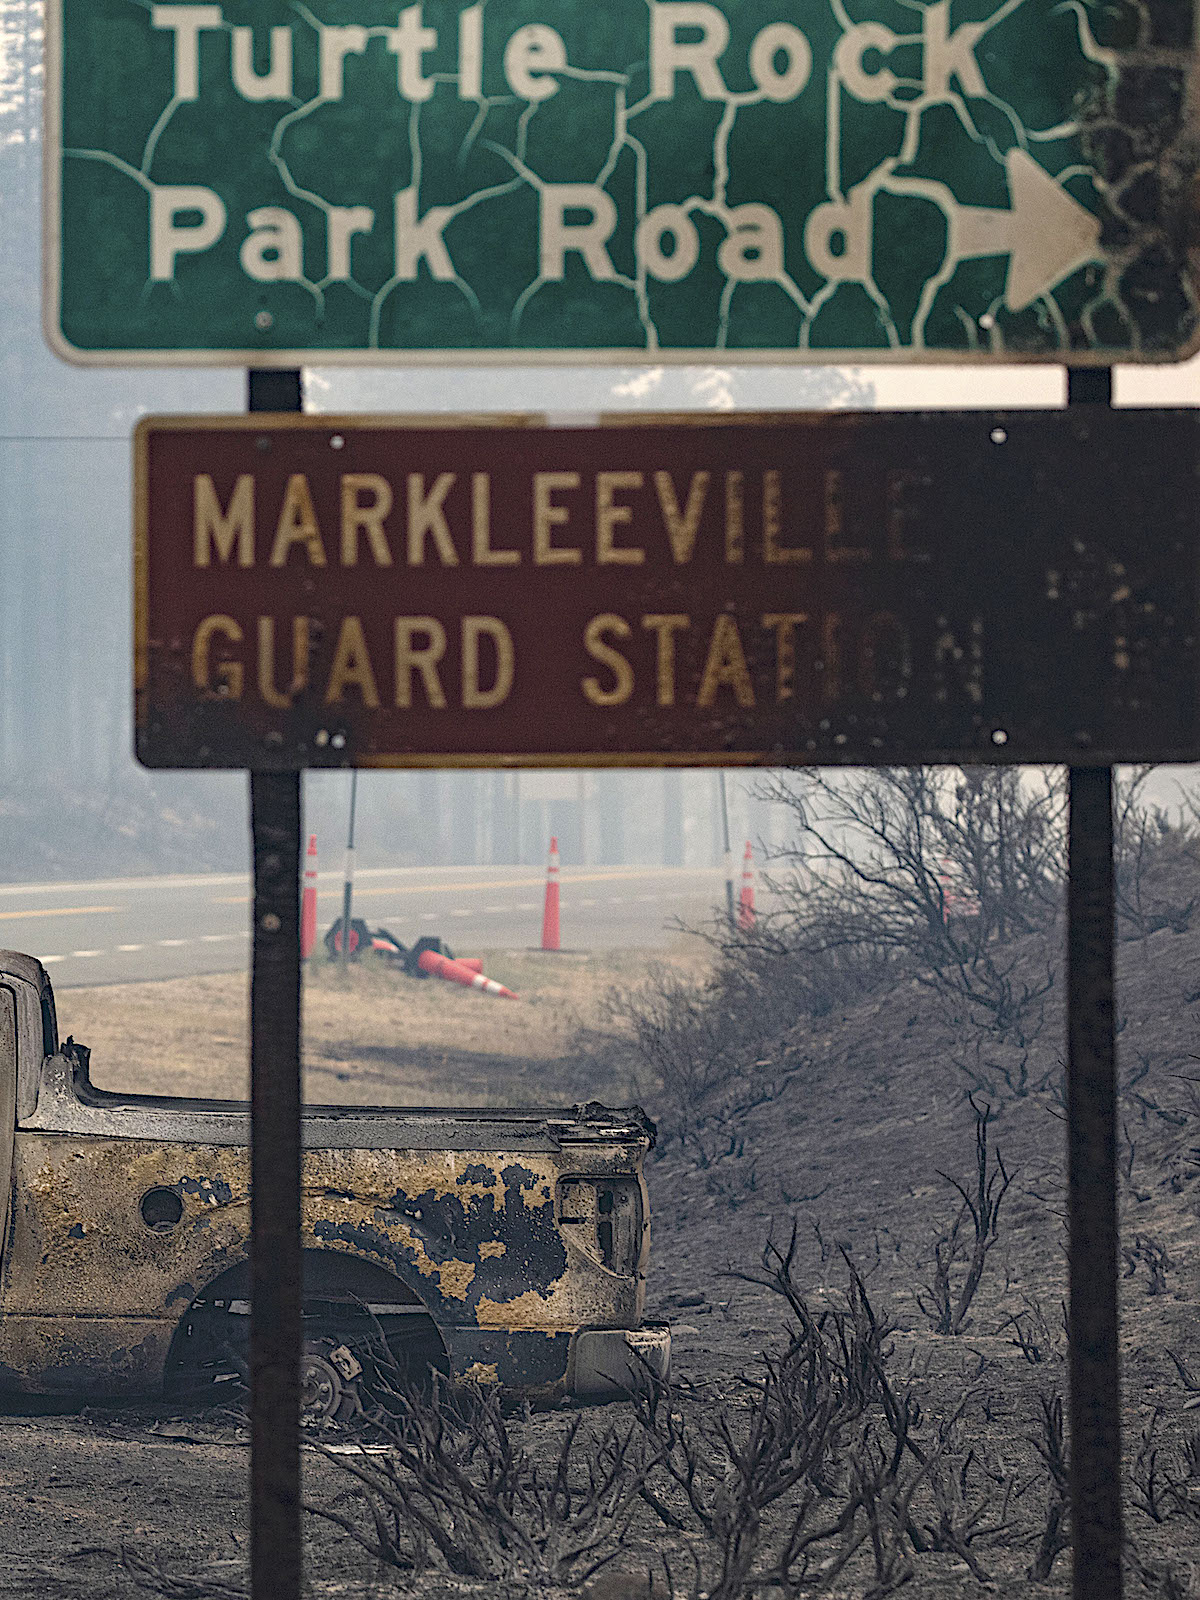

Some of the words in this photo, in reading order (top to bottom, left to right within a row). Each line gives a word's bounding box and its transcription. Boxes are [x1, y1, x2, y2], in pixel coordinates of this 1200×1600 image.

[151, 4, 566, 102] Turtle
[649, 2, 992, 102] Rock
[150, 185, 460, 282] Park
[539, 184, 873, 281] Road
[193, 613, 515, 709] GUARD
